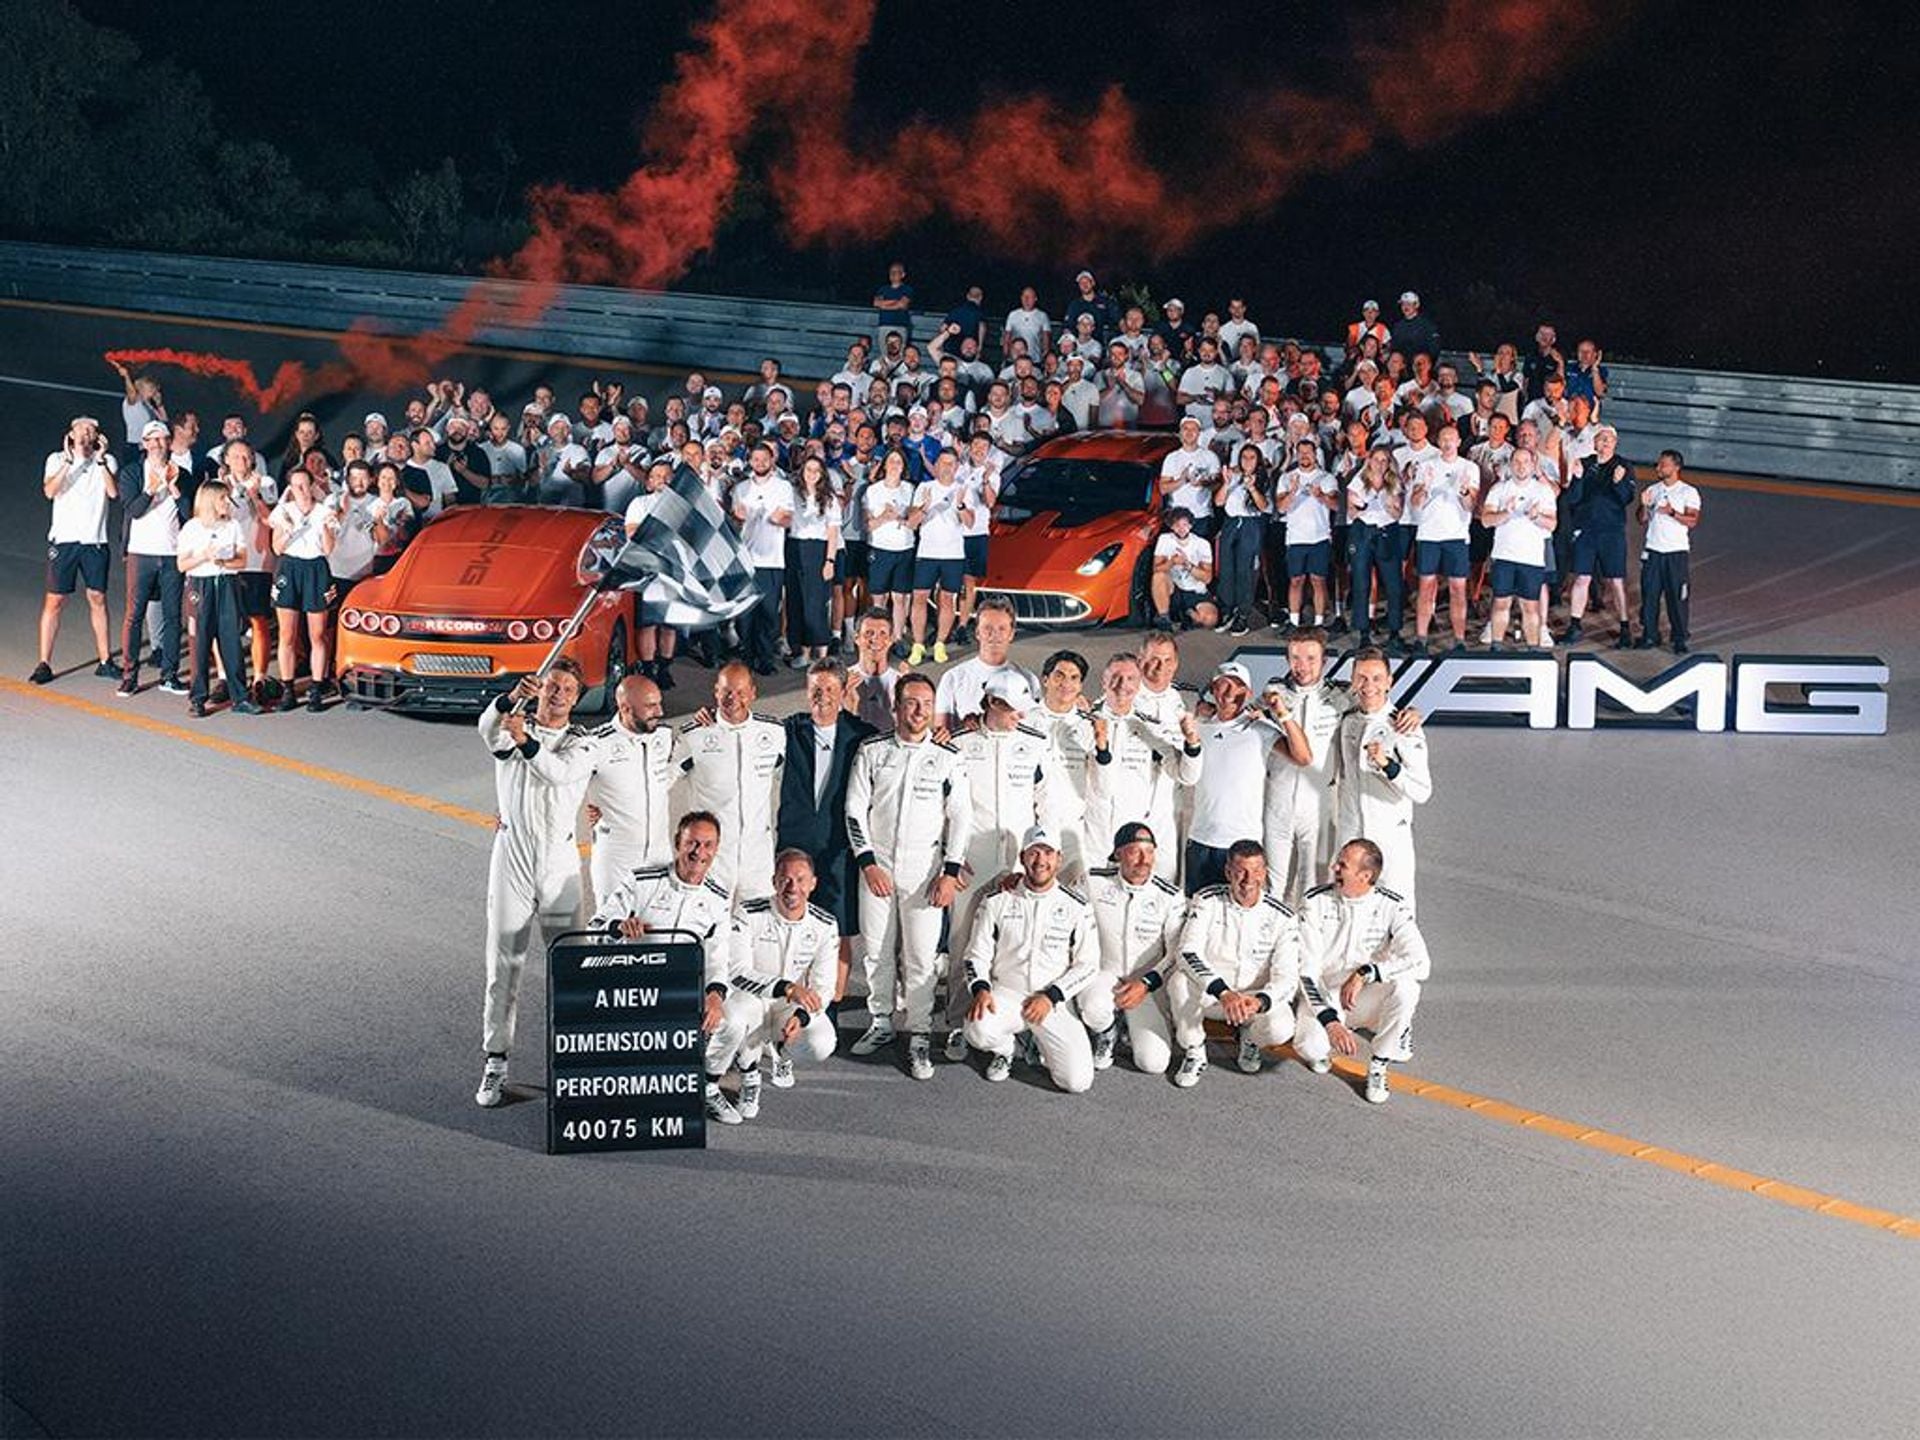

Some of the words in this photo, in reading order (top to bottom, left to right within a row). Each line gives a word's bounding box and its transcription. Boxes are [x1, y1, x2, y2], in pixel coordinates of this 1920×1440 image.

[425, 620, 485, 632] RECORD
[594, 988, 609, 1008] A
[613, 987, 659, 1008] NEW
[555, 1031, 667, 1053] DIMENSION
[672, 1029, 698, 1049] OF
[556, 1073, 698, 1097] PERFORMANCE
[562, 1117, 637, 1141] 40075
[651, 1116, 684, 1137] KM
